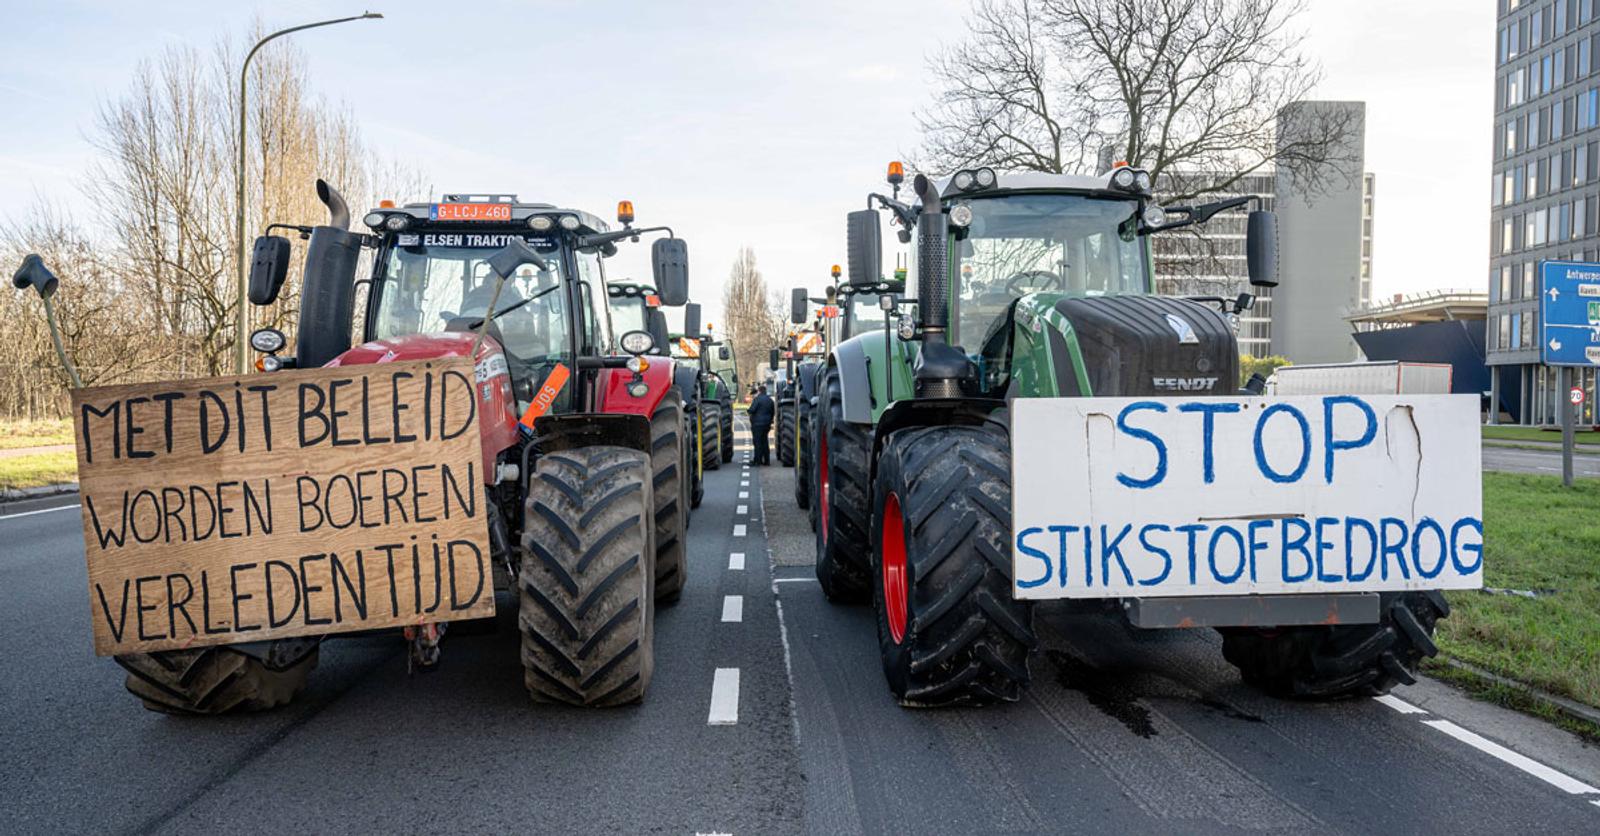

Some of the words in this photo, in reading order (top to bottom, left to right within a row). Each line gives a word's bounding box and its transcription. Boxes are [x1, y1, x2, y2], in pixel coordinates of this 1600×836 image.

[423, 234, 463, 246] ELSEN
[467, 234, 524, 247] TRAKTO
[81, 392, 186, 464] MET
[199, 381, 278, 455] DIT
[299, 363, 476, 448] BELEID
[536, 385, 556, 410] JOS
[1152, 377, 1218, 390] FENDT
[1116, 395, 1378, 489] STOP
[86, 479, 273, 550] WORDEN
[297, 461, 476, 532] BOEREN
[1015, 515, 1484, 588] STIKSTOFBEDROG
[96, 549, 368, 644] VERLEDEN
